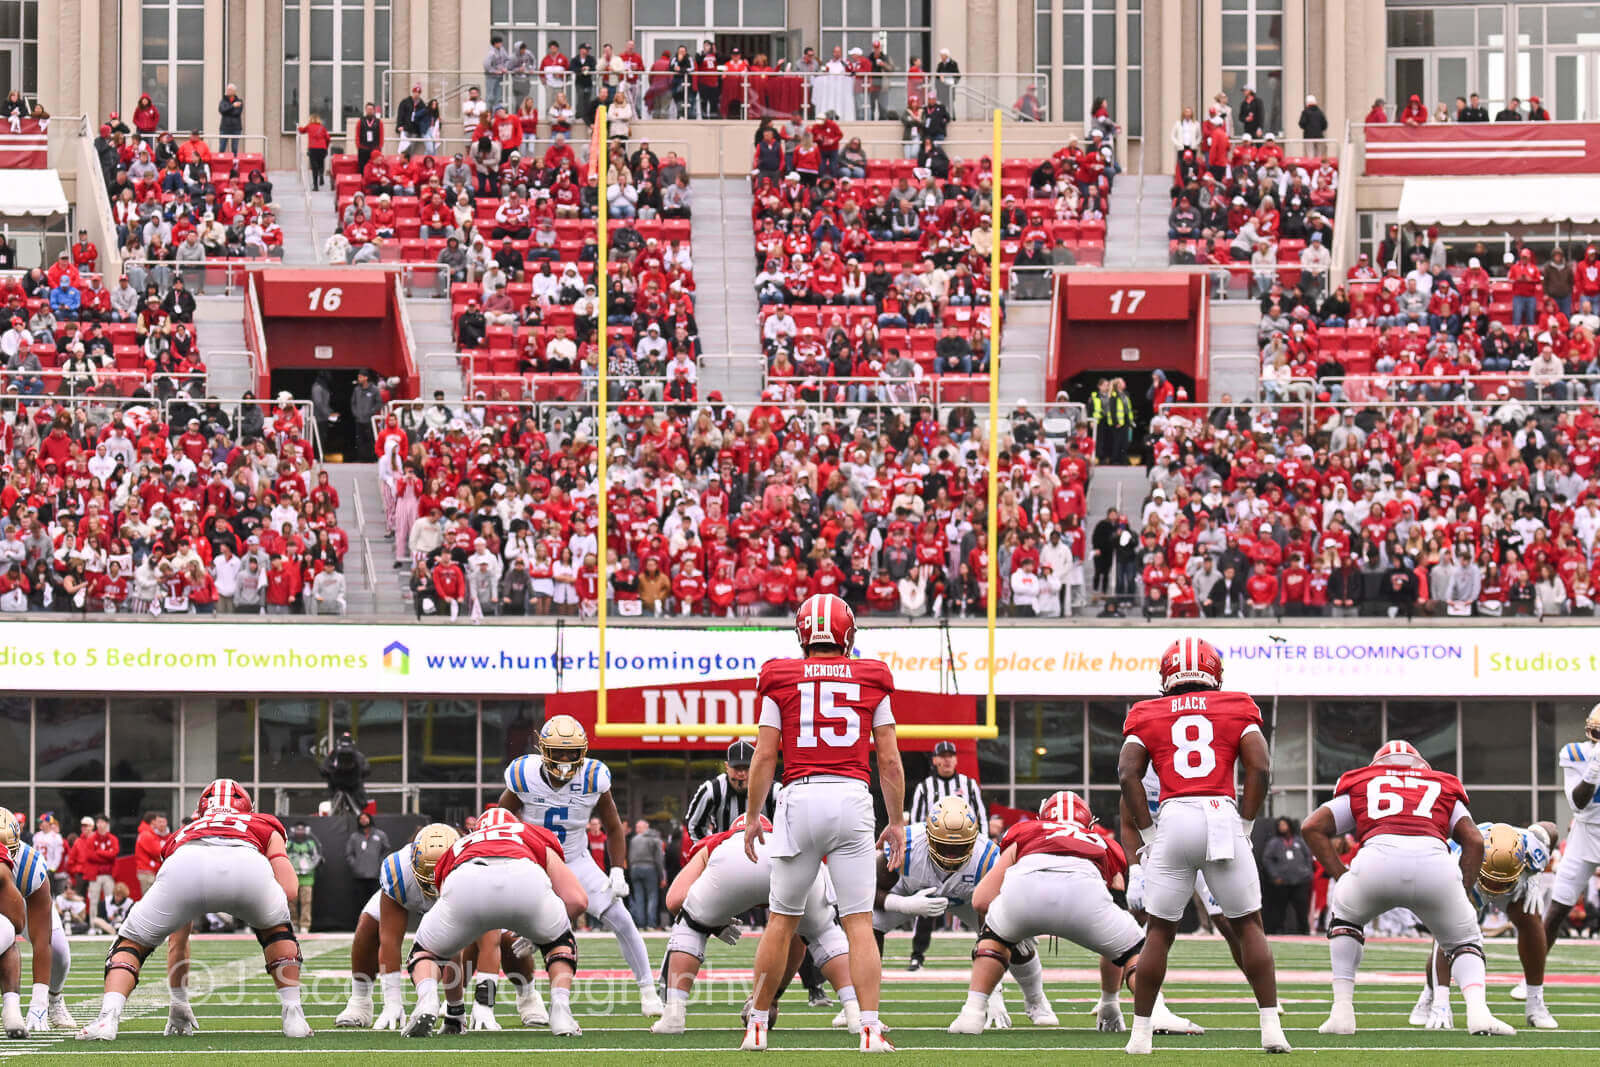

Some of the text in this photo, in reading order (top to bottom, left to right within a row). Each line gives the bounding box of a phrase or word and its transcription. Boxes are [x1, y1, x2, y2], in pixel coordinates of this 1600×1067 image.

[308, 287, 343, 311] 16
[1109, 289, 1146, 314] 17
[53, 648, 78, 667] to
[86, 648, 98, 667] 5
[106, 647, 217, 668] Bedroom
[224, 647, 369, 671] Townhomes
[426, 650, 756, 676] www.hunterbloomington
[993, 651, 1057, 677] place
[1062, 651, 1103, 672] like
[1110, 651, 1161, 672] hom
[1229, 645, 1463, 660] HUNTER BLOOMINGTON
[1488, 651, 1600, 672] Studios t
[803, 663, 853, 679] MENDOZA
[641, 690, 758, 742] INDI
[796, 681, 861, 748] 15
[1171, 695, 1207, 713] BLACK
[1171, 714, 1217, 779] 8
[1366, 775, 1442, 820] 67
[543, 807, 569, 844] 6
